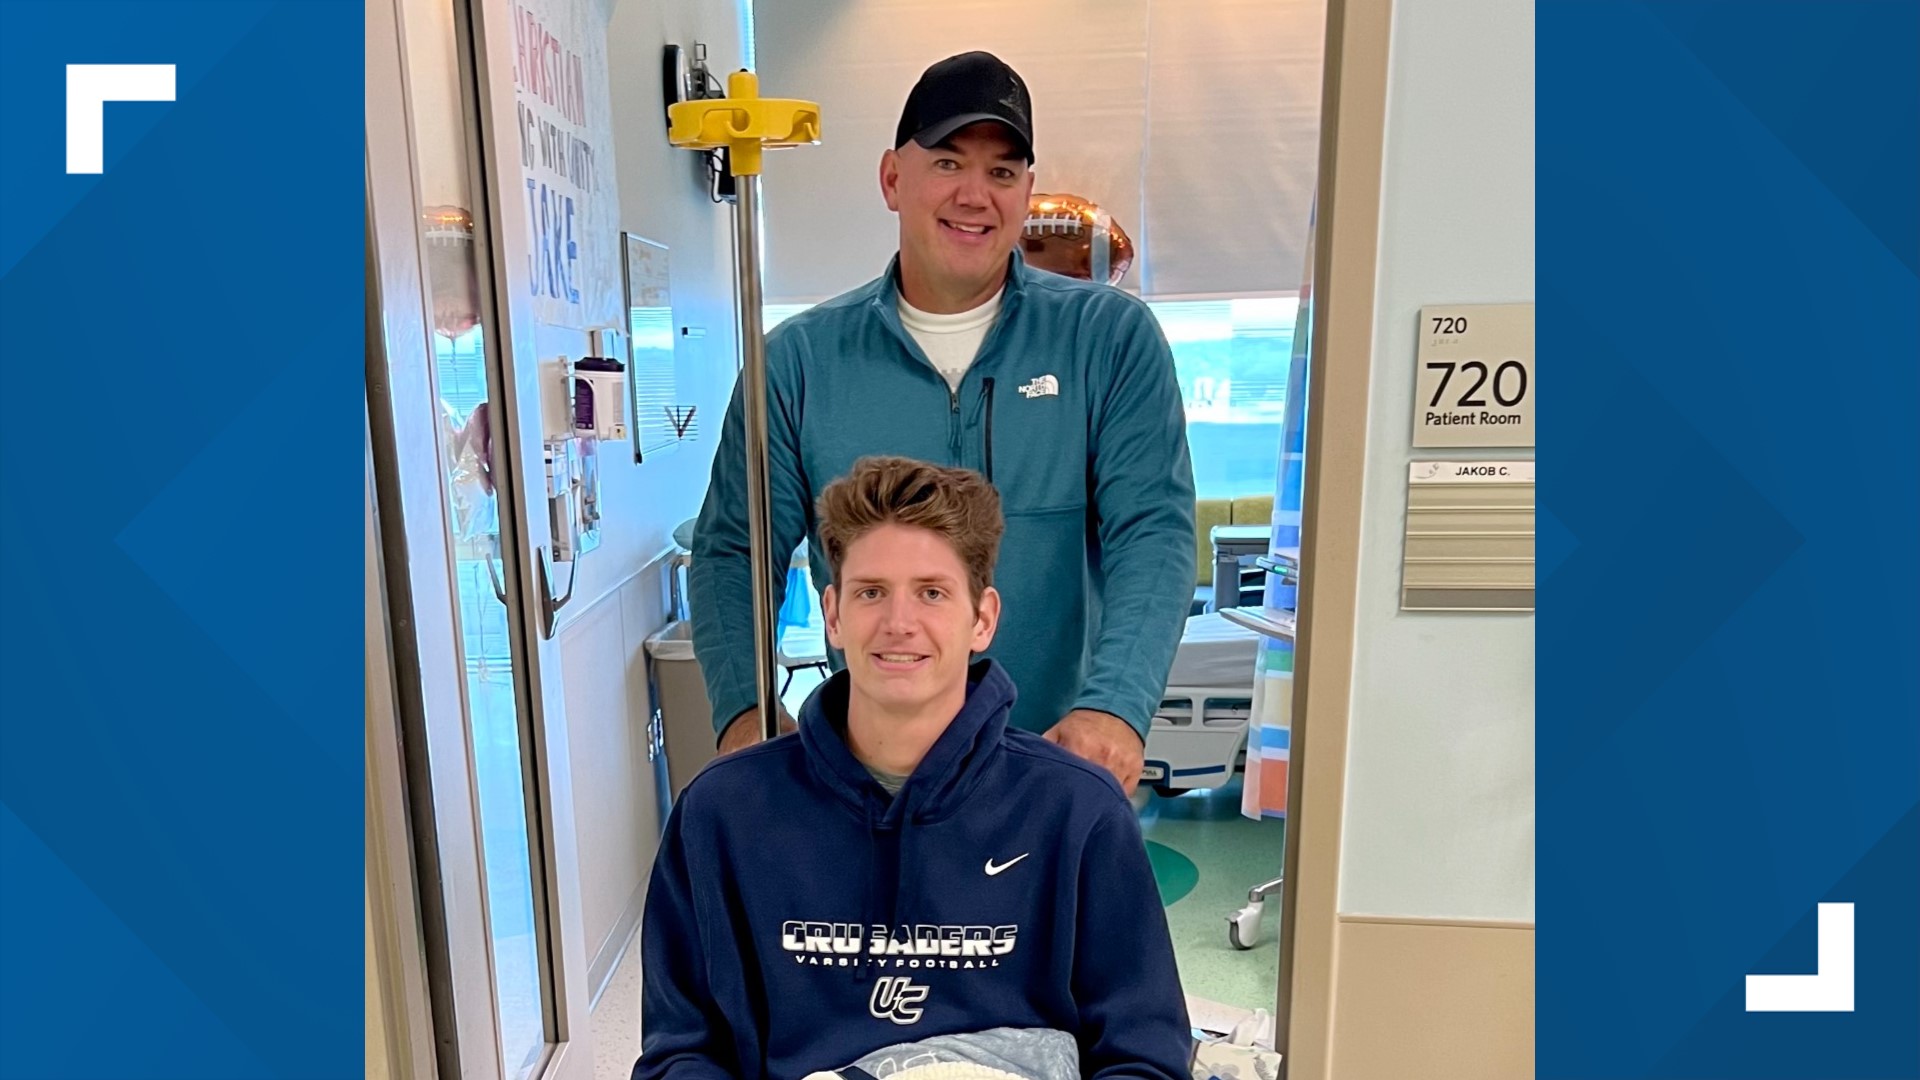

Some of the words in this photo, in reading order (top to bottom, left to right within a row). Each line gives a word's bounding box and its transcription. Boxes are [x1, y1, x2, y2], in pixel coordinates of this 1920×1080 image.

[537, 115, 567, 178] WITH
[526, 178, 580, 304] JAKE
[1432, 317, 1468, 334] 720
[1018, 384, 1046, 393] NORTH
[1030, 377, 1045, 386] THE
[1426, 360, 1528, 408] 720
[1026, 389, 1046, 398] FACE
[1425, 412, 1476, 426] Patient
[1480, 411, 1522, 425] Room
[1455, 466, 1496, 476] JAKOB
[1499, 466, 1511, 476] C.
[782, 920, 1018, 957] CRUSADERS
[895, 958, 1000, 969] FOOTBALL
